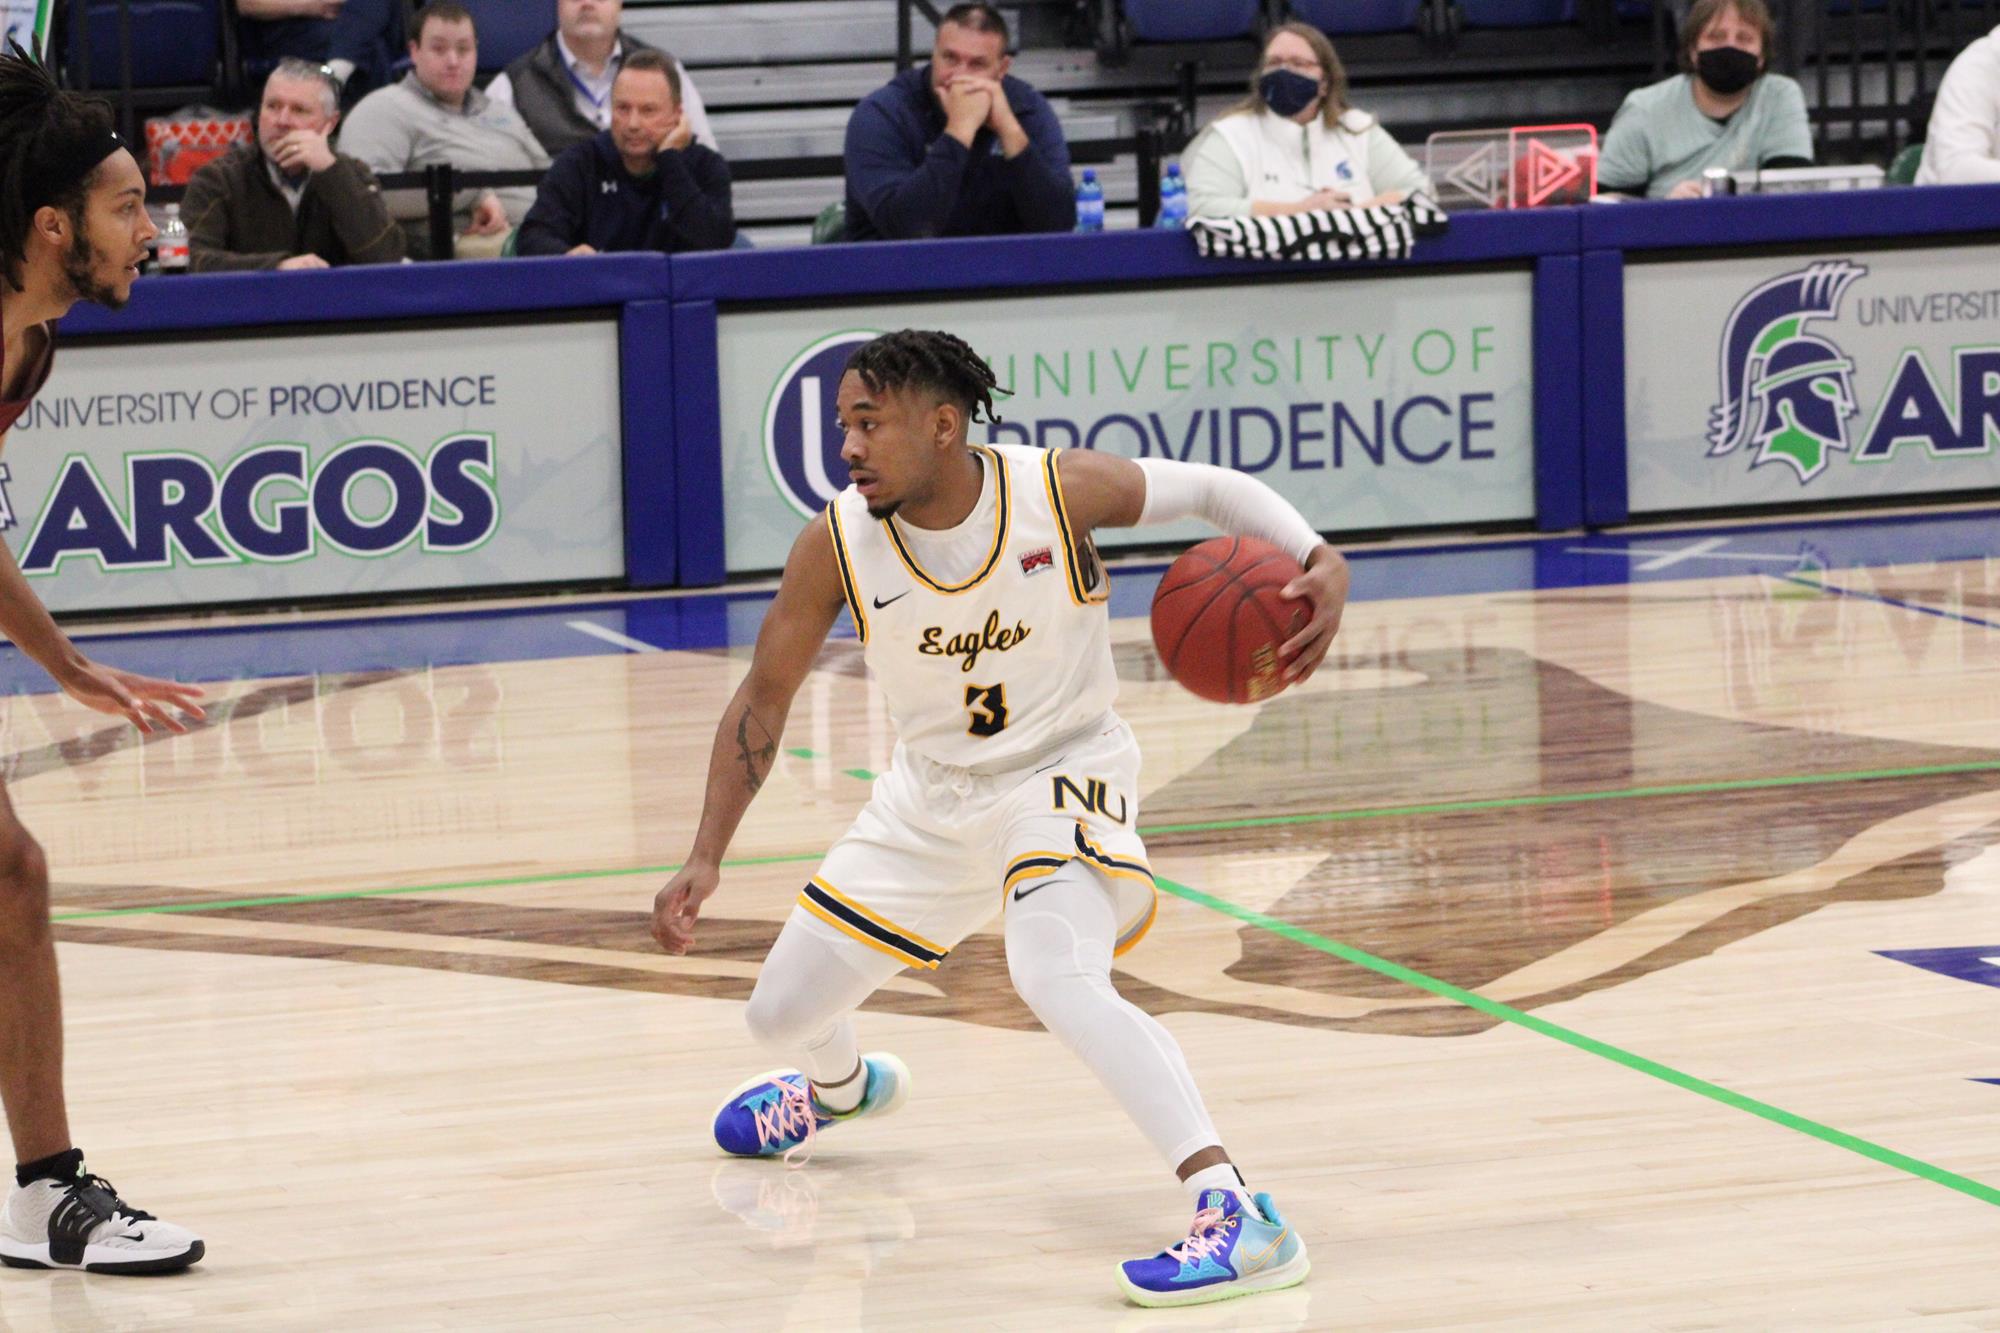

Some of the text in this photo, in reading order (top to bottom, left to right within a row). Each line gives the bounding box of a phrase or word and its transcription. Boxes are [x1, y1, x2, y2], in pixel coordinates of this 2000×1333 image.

[985, 326, 1495, 401] UNIVERSITY OF
[13, 374, 497, 430] UNIVERSITY OF PROVIDENCE
[17, 430, 501, 576] ARGOS
[918, 609, 1032, 673] Eagles
[963, 682, 1010, 739] 3
[1051, 775, 1127, 825] NU
